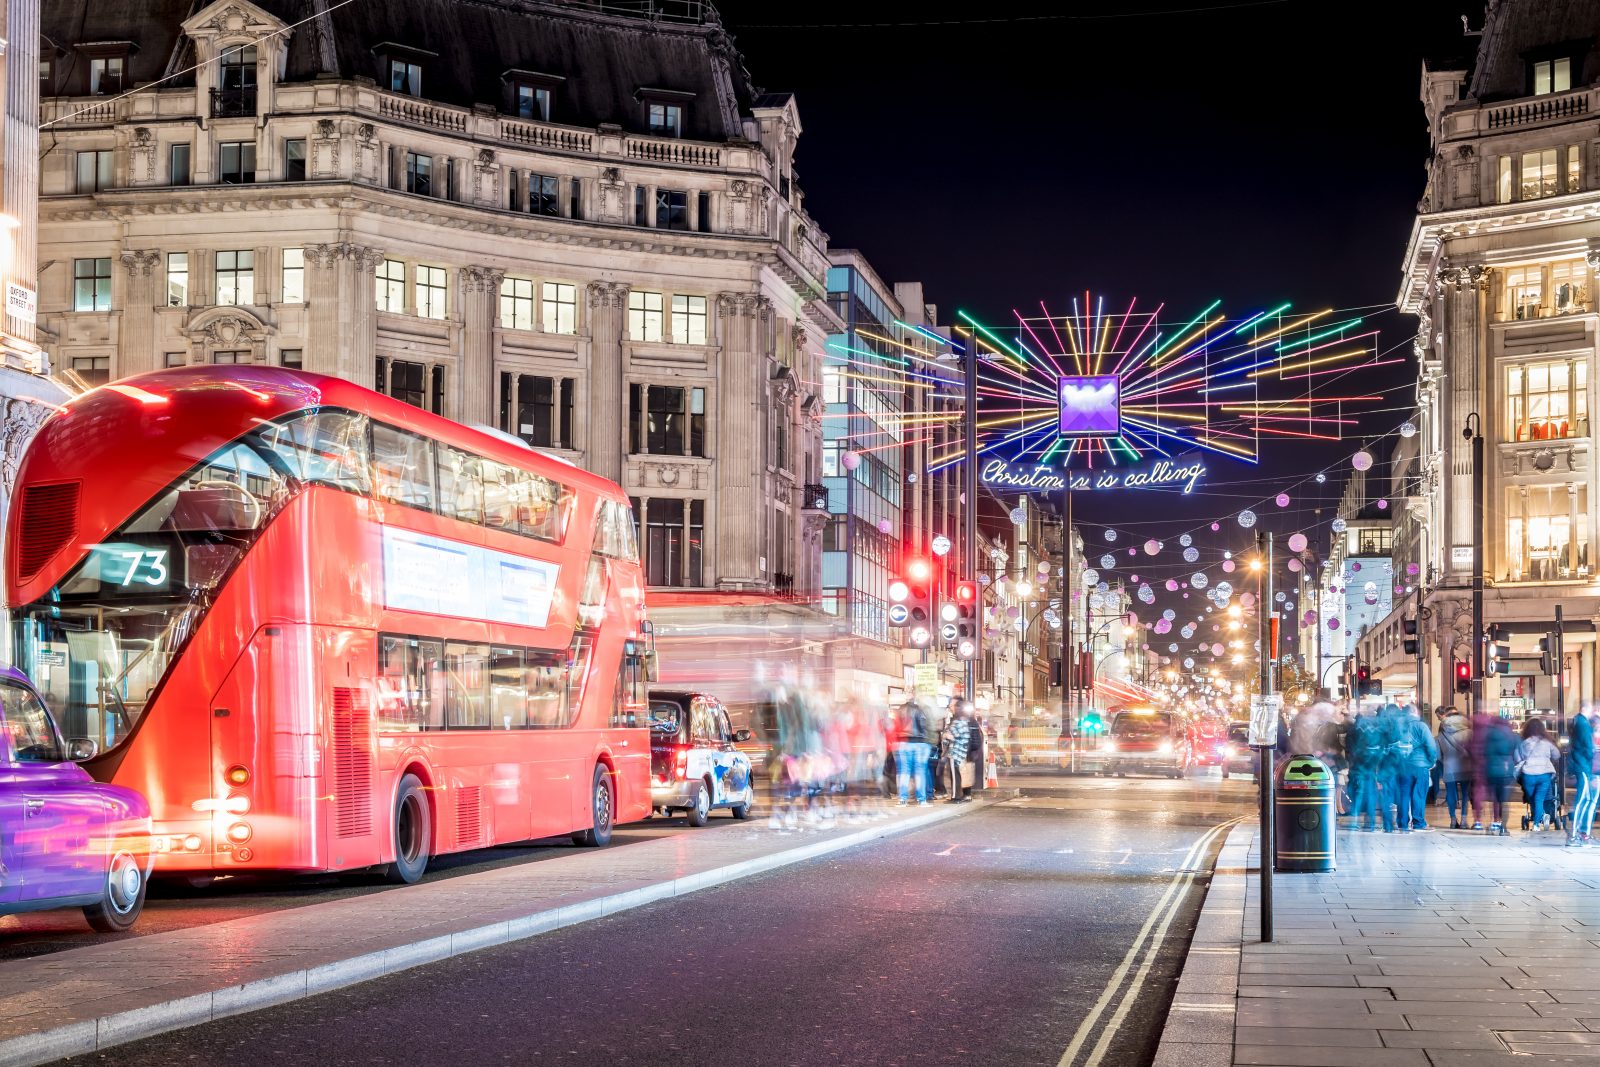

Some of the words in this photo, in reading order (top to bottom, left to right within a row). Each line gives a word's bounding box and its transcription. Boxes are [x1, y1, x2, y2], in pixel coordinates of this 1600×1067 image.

[10, 286, 28, 300] OXFORD
[10, 296, 26, 309] STREET
[1096, 470, 1119, 489] is
[1124, 461, 1207, 494] calling
[122, 550, 167, 586] 73
